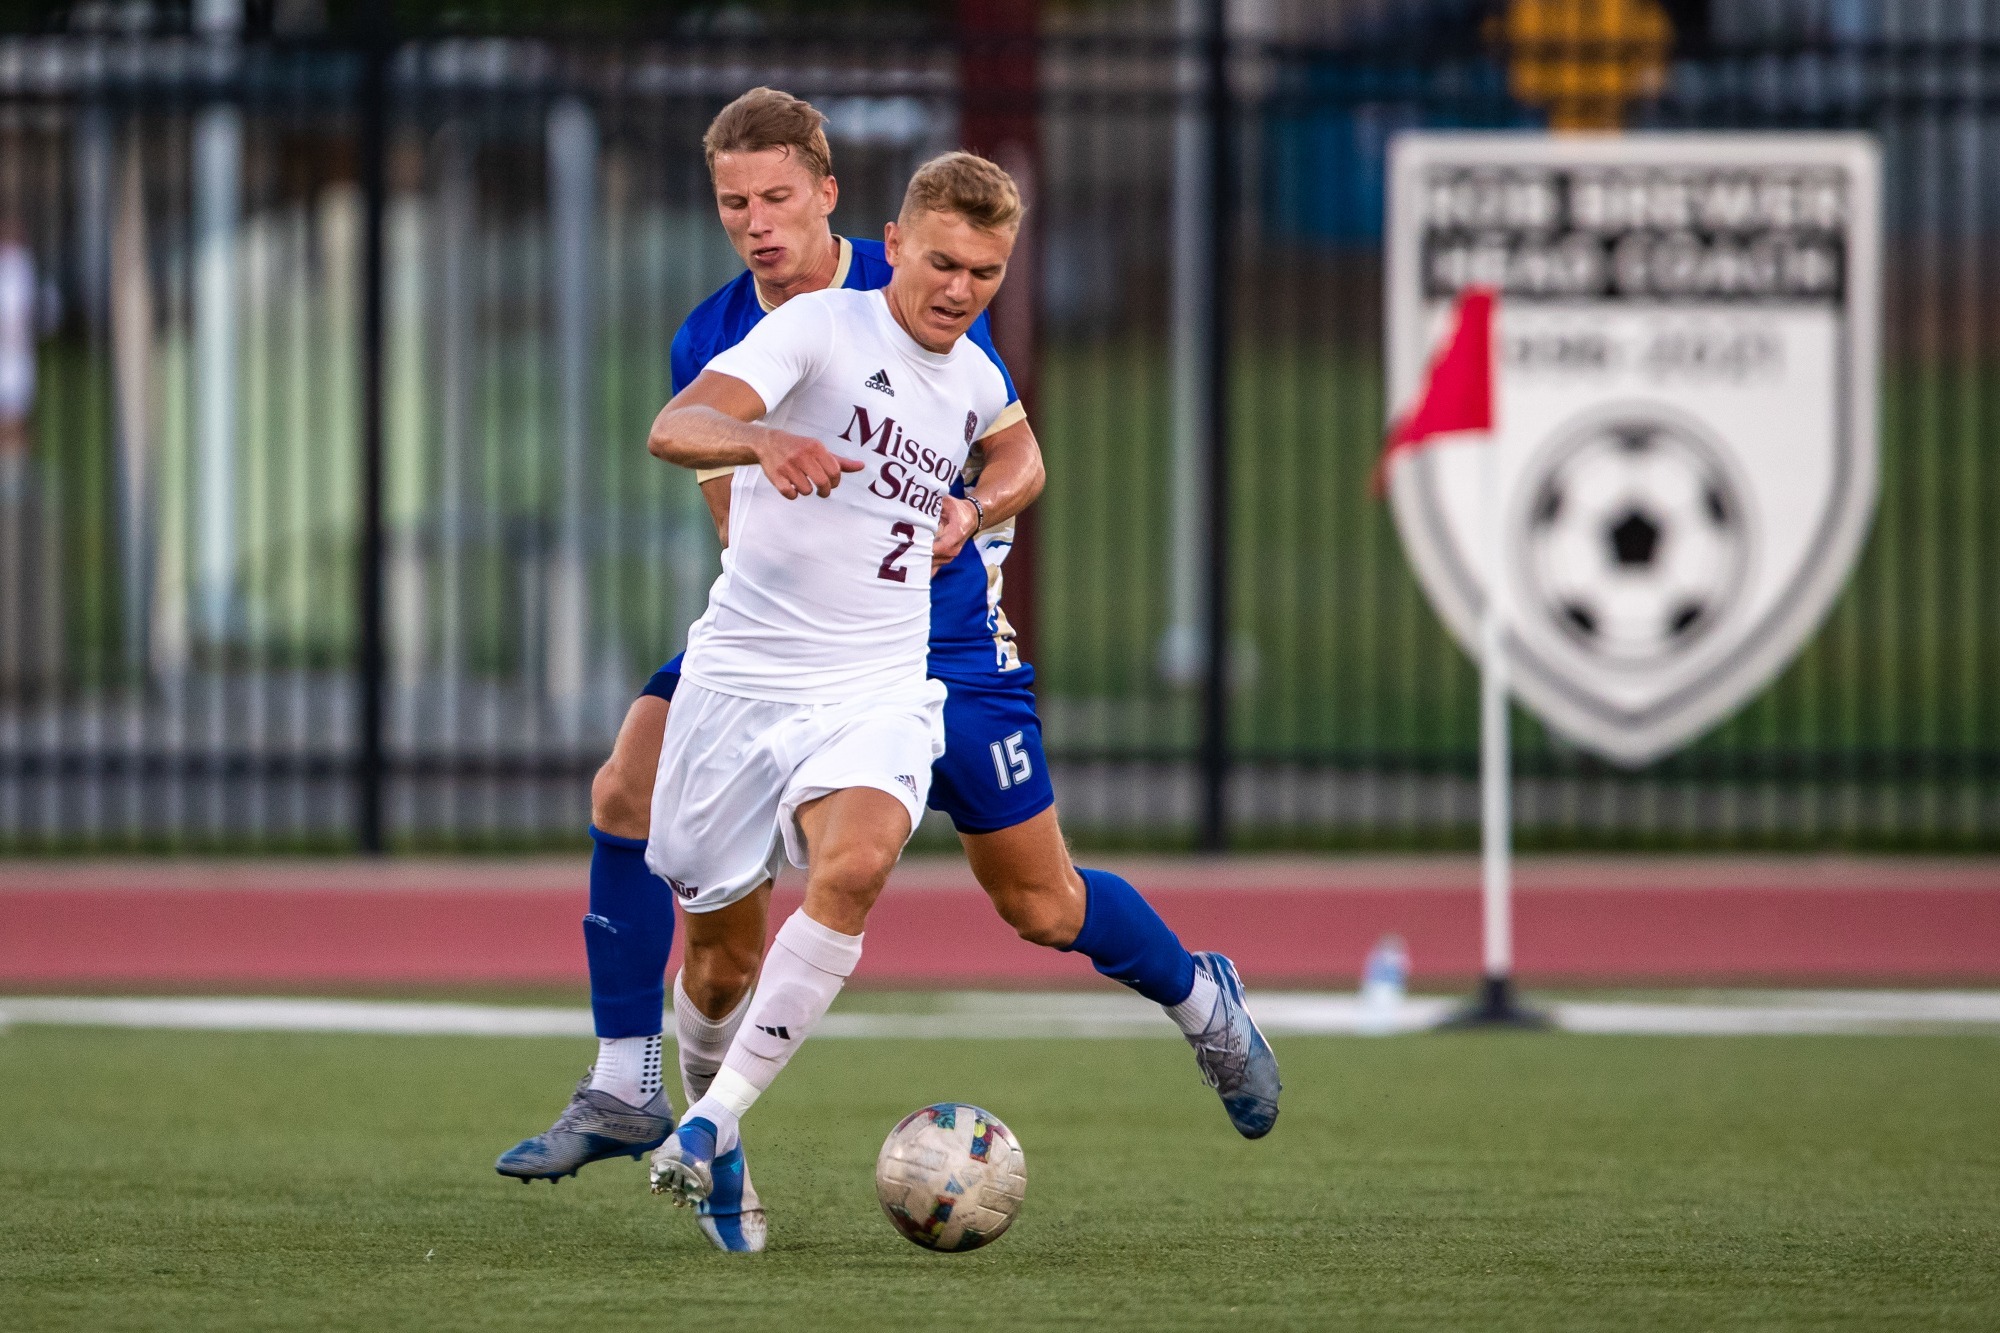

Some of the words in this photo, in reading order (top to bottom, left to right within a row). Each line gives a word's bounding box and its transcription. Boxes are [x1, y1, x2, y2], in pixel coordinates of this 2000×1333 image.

[865, 380, 895, 397] adidas
[868, 461, 942, 518] State
[877, 521, 915, 583] 2
[990, 731, 1032, 790] 15
